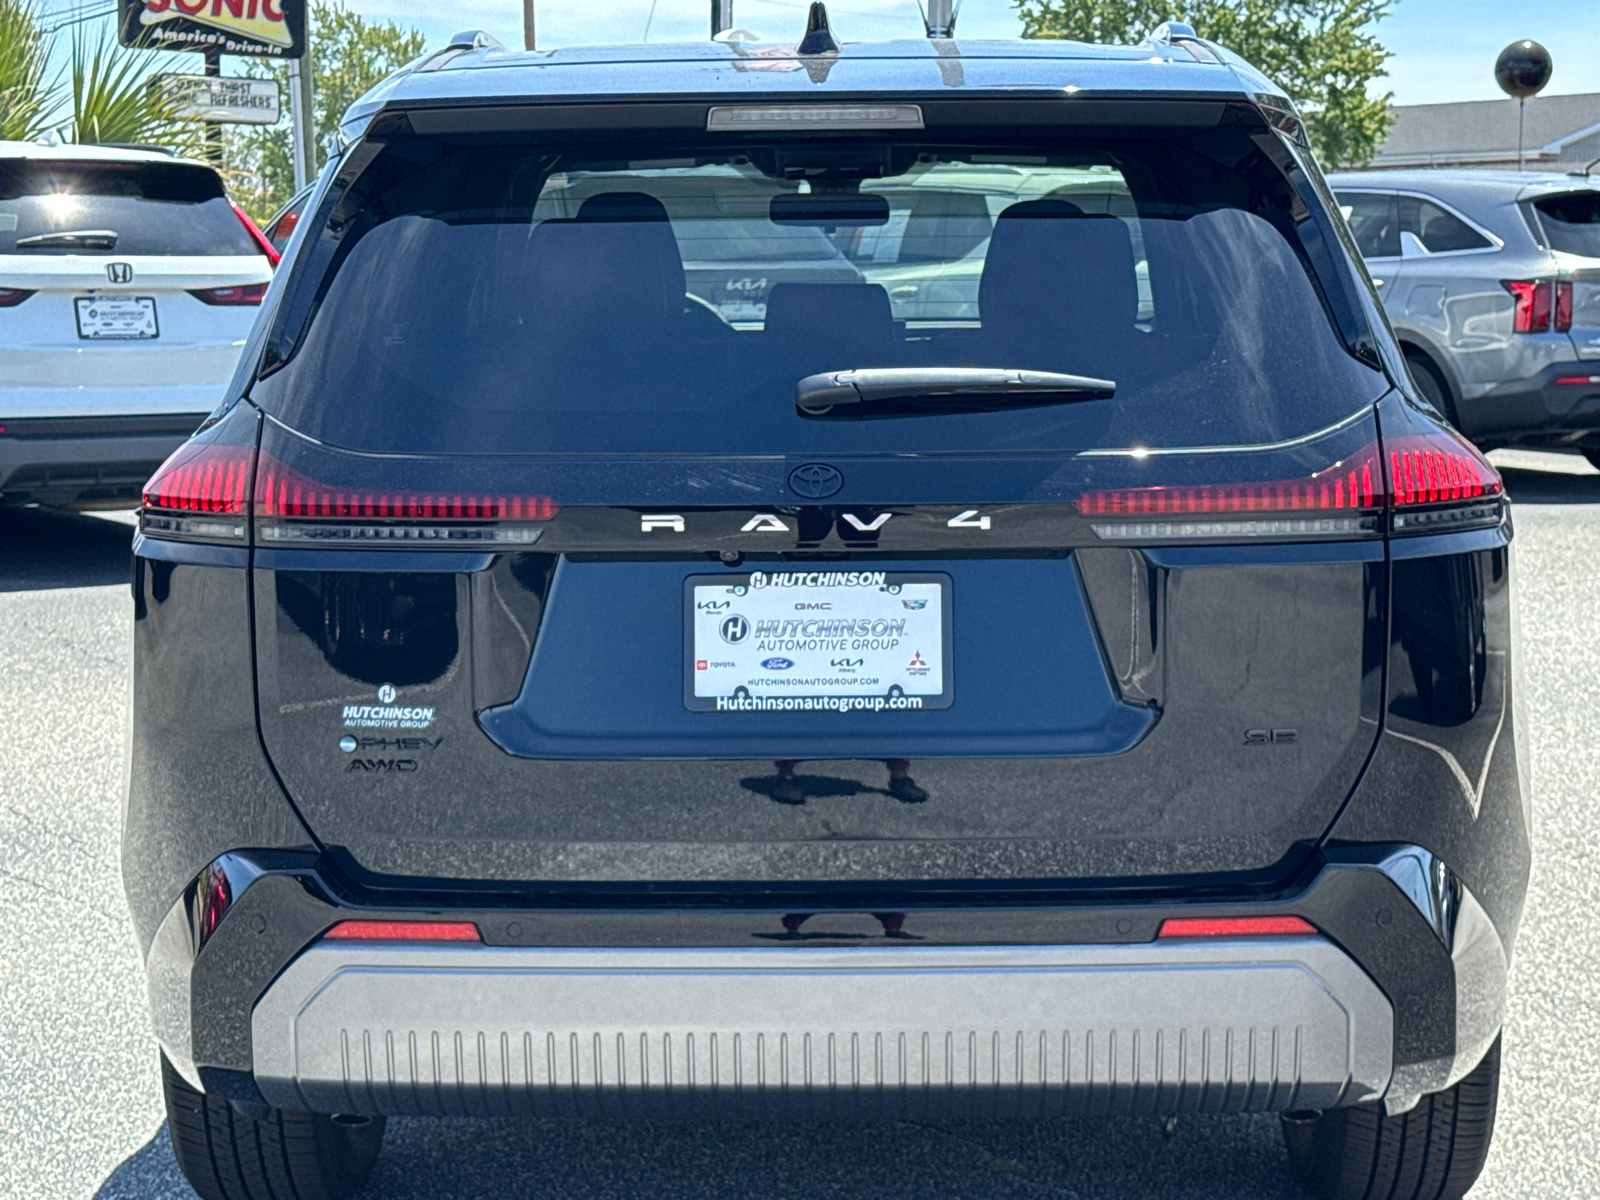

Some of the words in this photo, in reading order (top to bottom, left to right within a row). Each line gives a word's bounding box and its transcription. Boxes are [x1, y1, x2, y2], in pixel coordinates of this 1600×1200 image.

[152, 27, 226, 45] America's
[770, 571, 886, 588] HUTCHINSON
[794, 602, 832, 611] GMC
[754, 618, 906, 639] HUTCHINSON
[757, 639, 847, 651] AUTOMOTIVE
[851, 638, 899, 651] GROUP
[765, 658, 790, 669] Ford
[747, 677, 879, 686] HUTCHINSONAUTOGROUP.COM
[716, 695, 923, 712] Hutchinsonautogroup.com
[342, 705, 434, 720] HUTCHINSON
[344, 719, 398, 728] AUTOMOTIVE
[400, 719, 430, 729] GROUP
[345, 759, 419, 773] AWD
